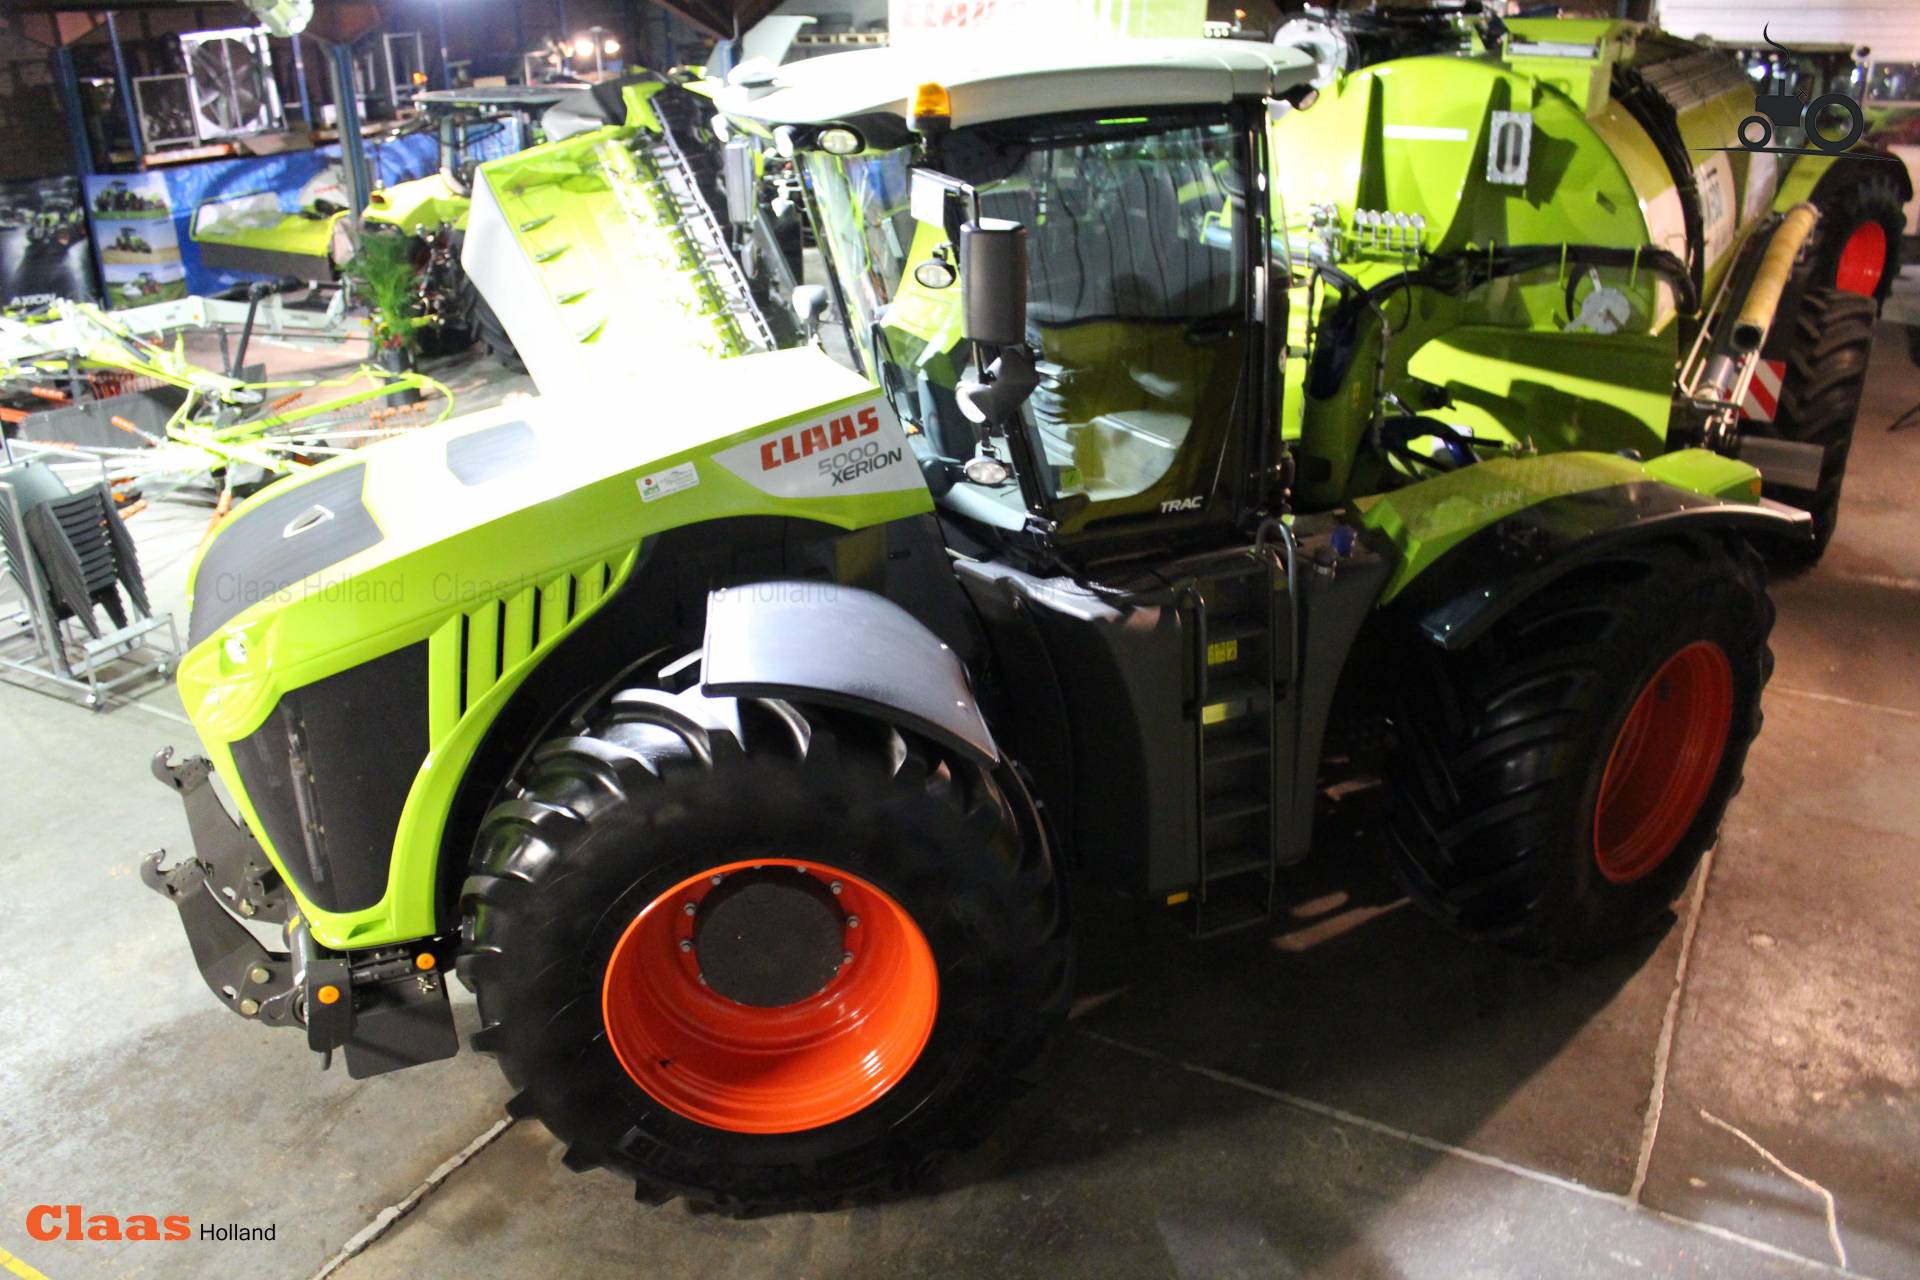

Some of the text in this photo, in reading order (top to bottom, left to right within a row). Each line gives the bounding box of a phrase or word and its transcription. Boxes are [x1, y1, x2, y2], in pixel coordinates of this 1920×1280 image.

[901, 0, 1020, 27] CLAA
[760, 406, 880, 471] CLAAS
[817, 441, 879, 476] 5000
[831, 447, 903, 487] XERION
[1160, 496, 1204, 514] TRAC
